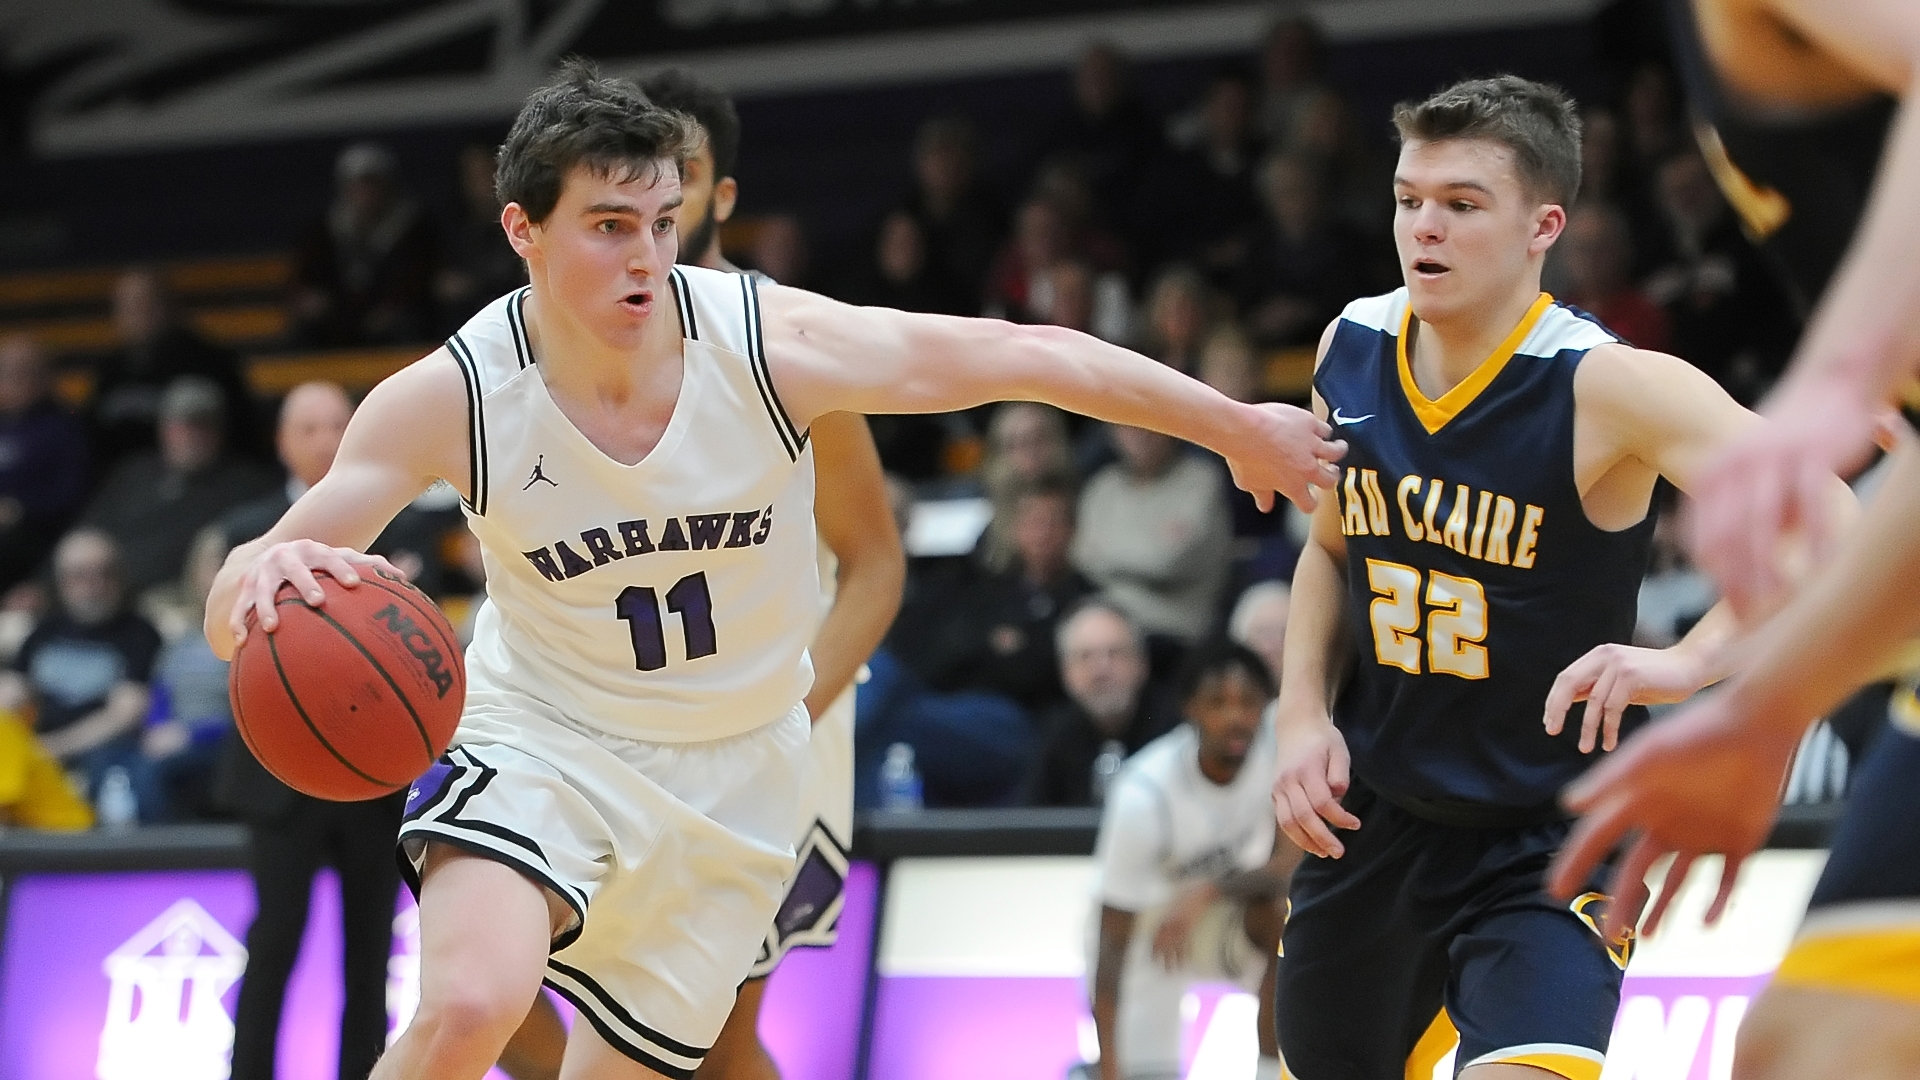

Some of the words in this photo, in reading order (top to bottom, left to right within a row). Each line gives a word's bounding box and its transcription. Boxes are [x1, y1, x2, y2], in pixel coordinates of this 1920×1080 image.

[521, 503, 774, 582] WARHAWKS
[1339, 467, 1391, 537] AU
[1397, 474, 1545, 569] CLAIRE
[373, 603, 454, 700] NCAA
[615, 570, 717, 671] 11
[1365, 557, 1490, 680] 22
